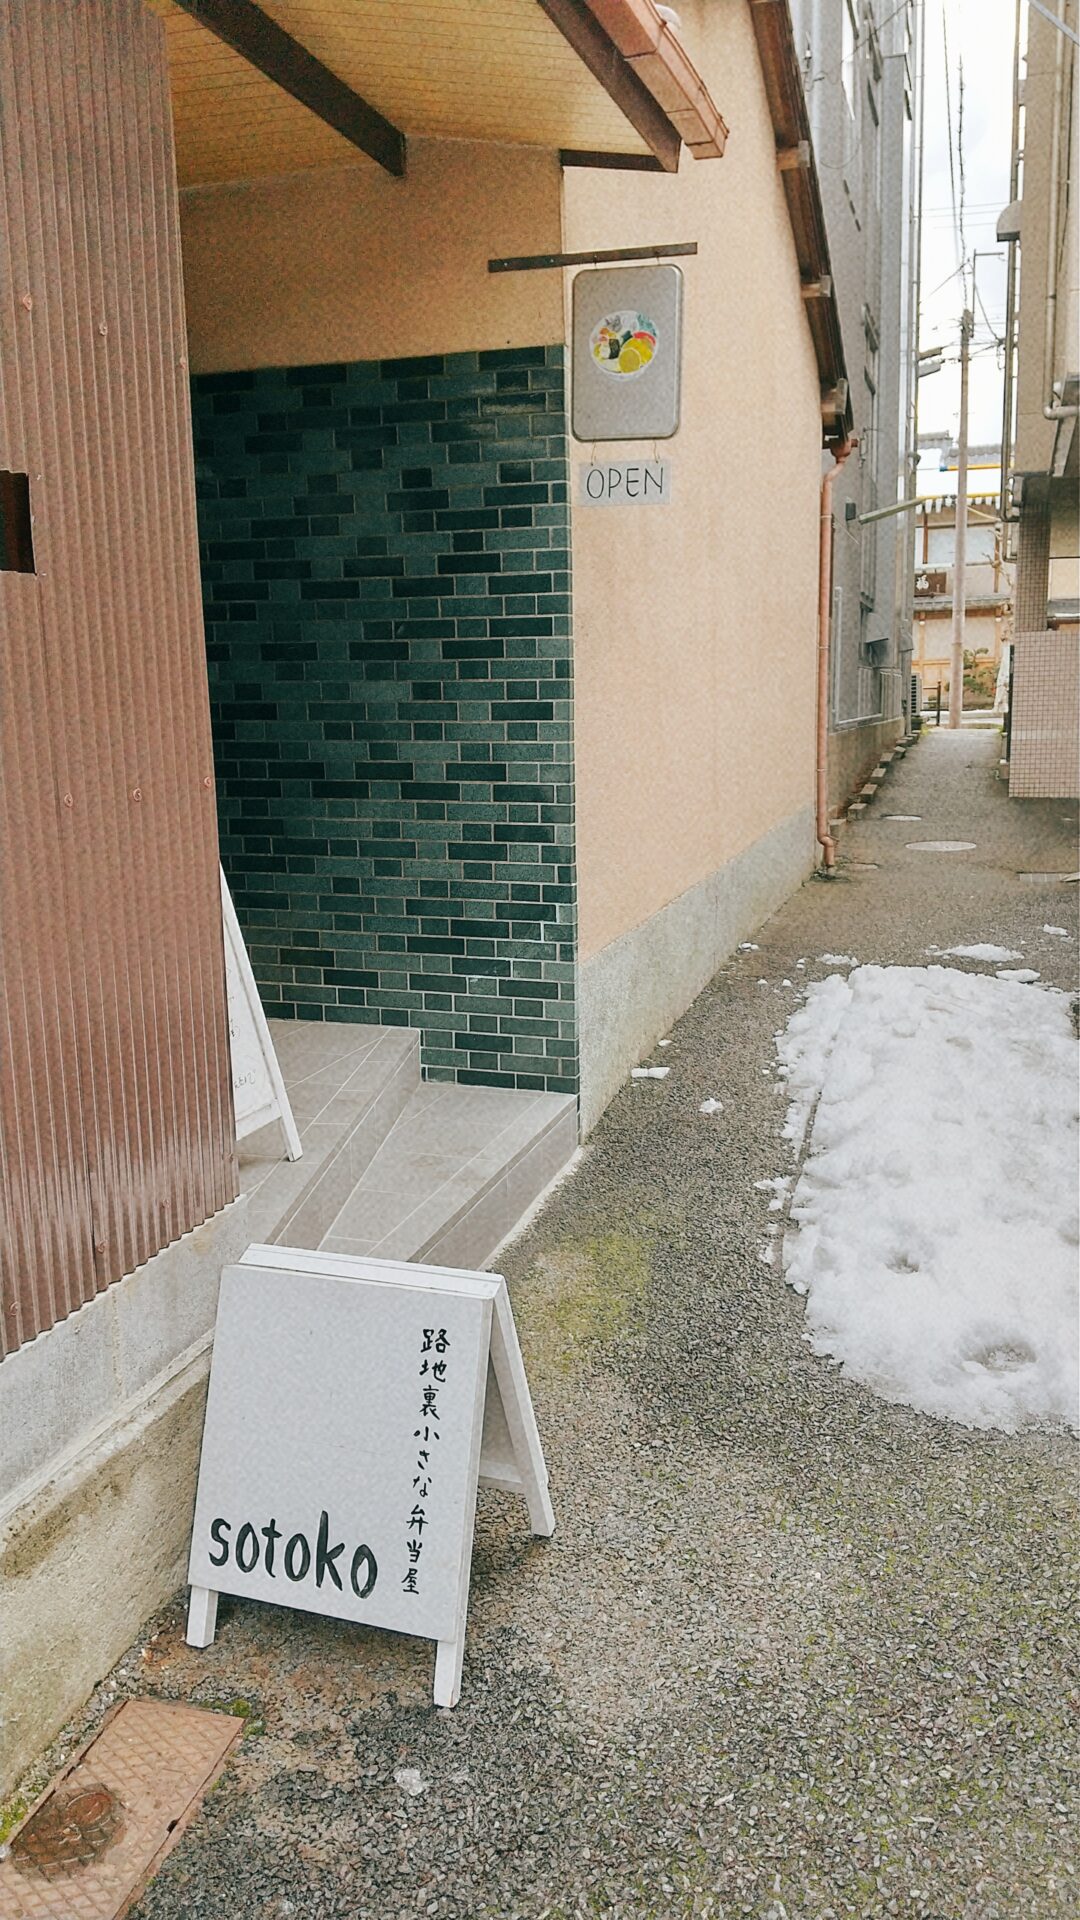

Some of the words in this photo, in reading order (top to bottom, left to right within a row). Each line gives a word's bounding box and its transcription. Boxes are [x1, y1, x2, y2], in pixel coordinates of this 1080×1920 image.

[586, 467, 663, 499] OPEN
[401, 1328, 451, 1595] 路地裏小さな弁当屋
[209, 1510, 378, 1599] sotoko
